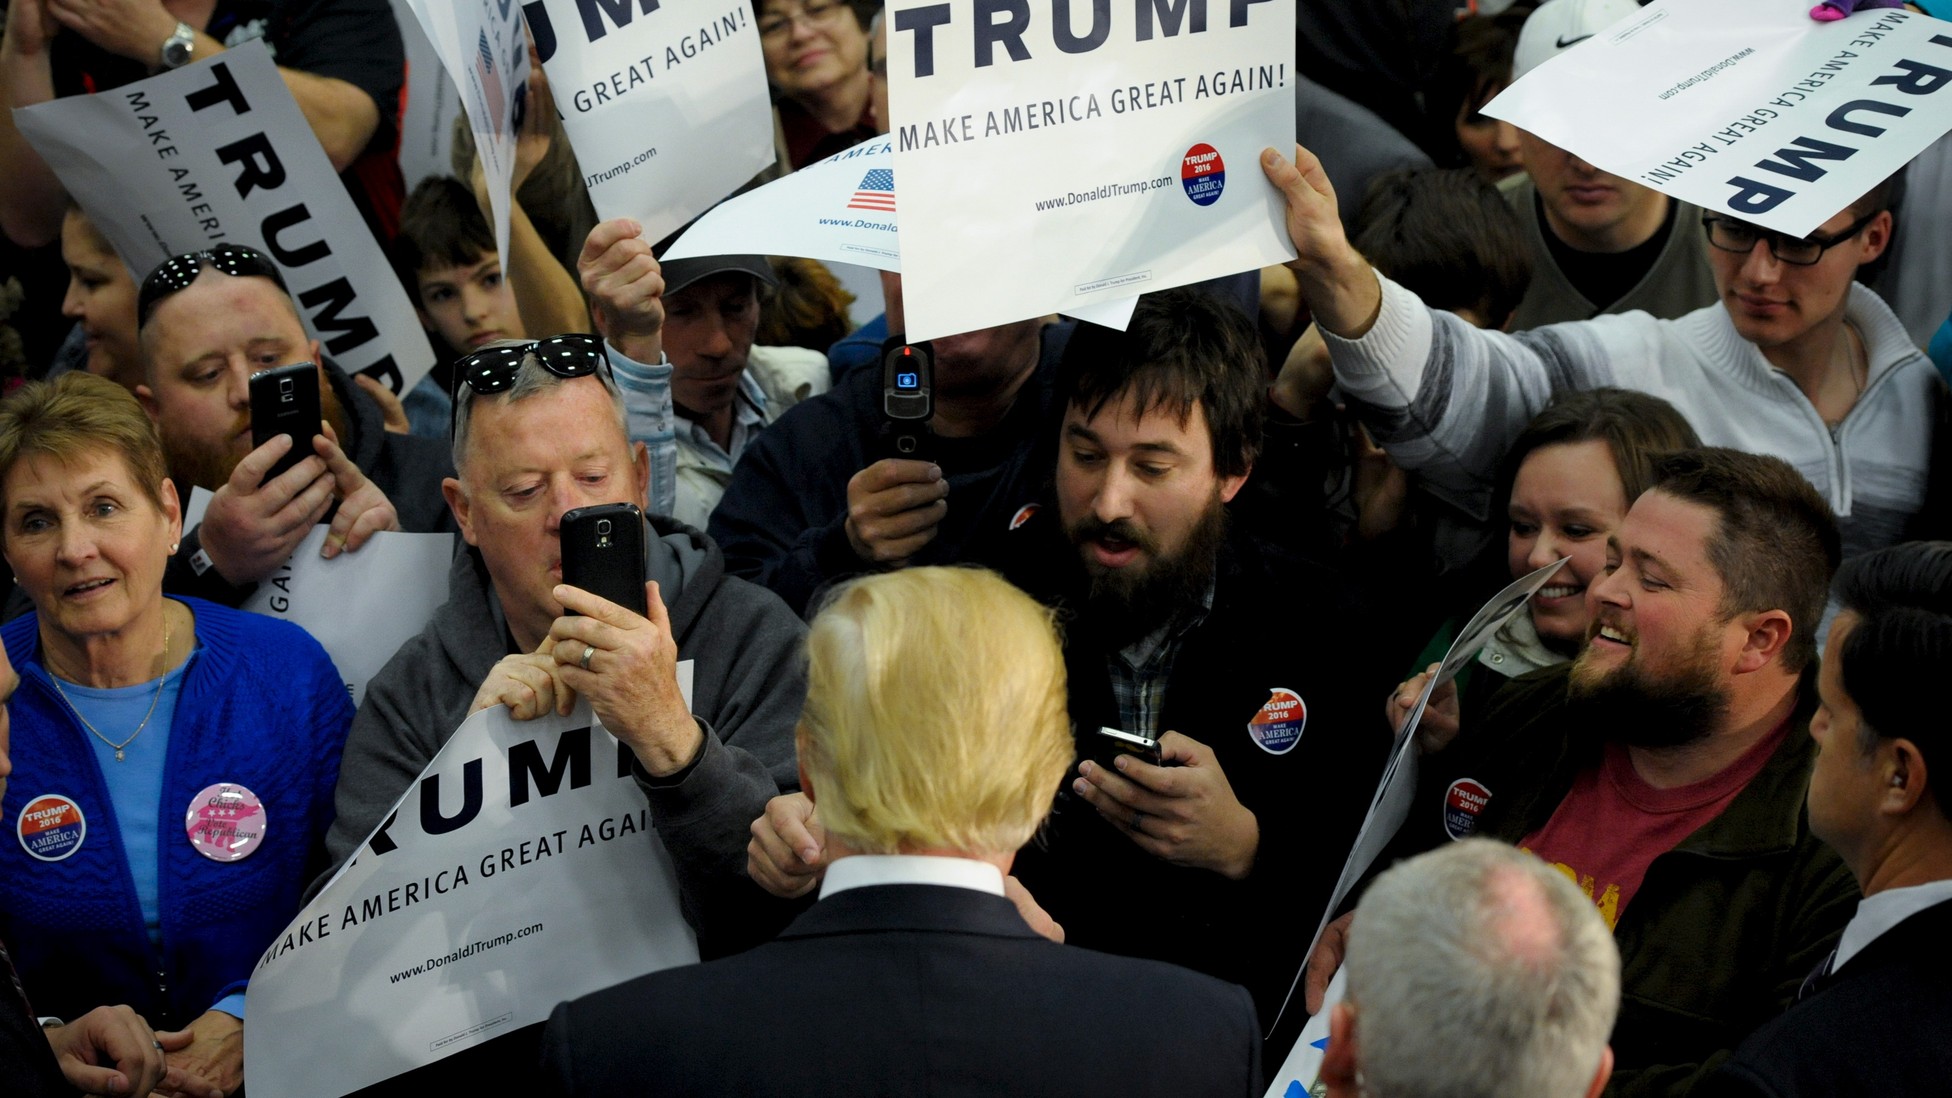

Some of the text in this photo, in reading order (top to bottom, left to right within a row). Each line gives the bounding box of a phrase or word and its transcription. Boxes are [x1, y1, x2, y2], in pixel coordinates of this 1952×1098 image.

[574, 56, 655, 113] GREAT
[666, 7, 747, 70] AGAIN!
[1658, 47, 1755, 100] www.DonaldJTrump.com
[1641, 12, 1909, 185] MAKE AMERICA GREAT AGAIN!
[899, 63, 1284, 153] MAKE AMERICA GREAT AGAIN!
[1725, 34, 1952, 214] RUMP
[126, 91, 179, 159] MAKE
[168, 168, 226, 240] AMERI
[1184, 151, 1218, 166] TRUMP
[1194, 163, 1211, 174] 2016
[1035, 175, 1172, 212] www.DonaldJTrump.com
[1187, 180, 1223, 195] AMERICA
[185, 62, 404, 397] TRUMP
[1259, 700, 1298, 712] RUMP
[1268, 711, 1289, 720] 2016
[1260, 728, 1299, 740] AMERICA
[208, 797, 245, 810] Chicks
[1460, 799, 1479, 812] 2016
[25, 804, 70, 821] TRUMP
[39, 815, 62, 828] 2016
[207, 817, 227, 828] Vote
[31, 830, 79, 849] AMERICA
[197, 825, 257, 839] Republican
[259, 810, 656, 969] MAKE AMERICA GREAT AGAI
[390, 923, 543, 984] www.DonaldJTrump.com
